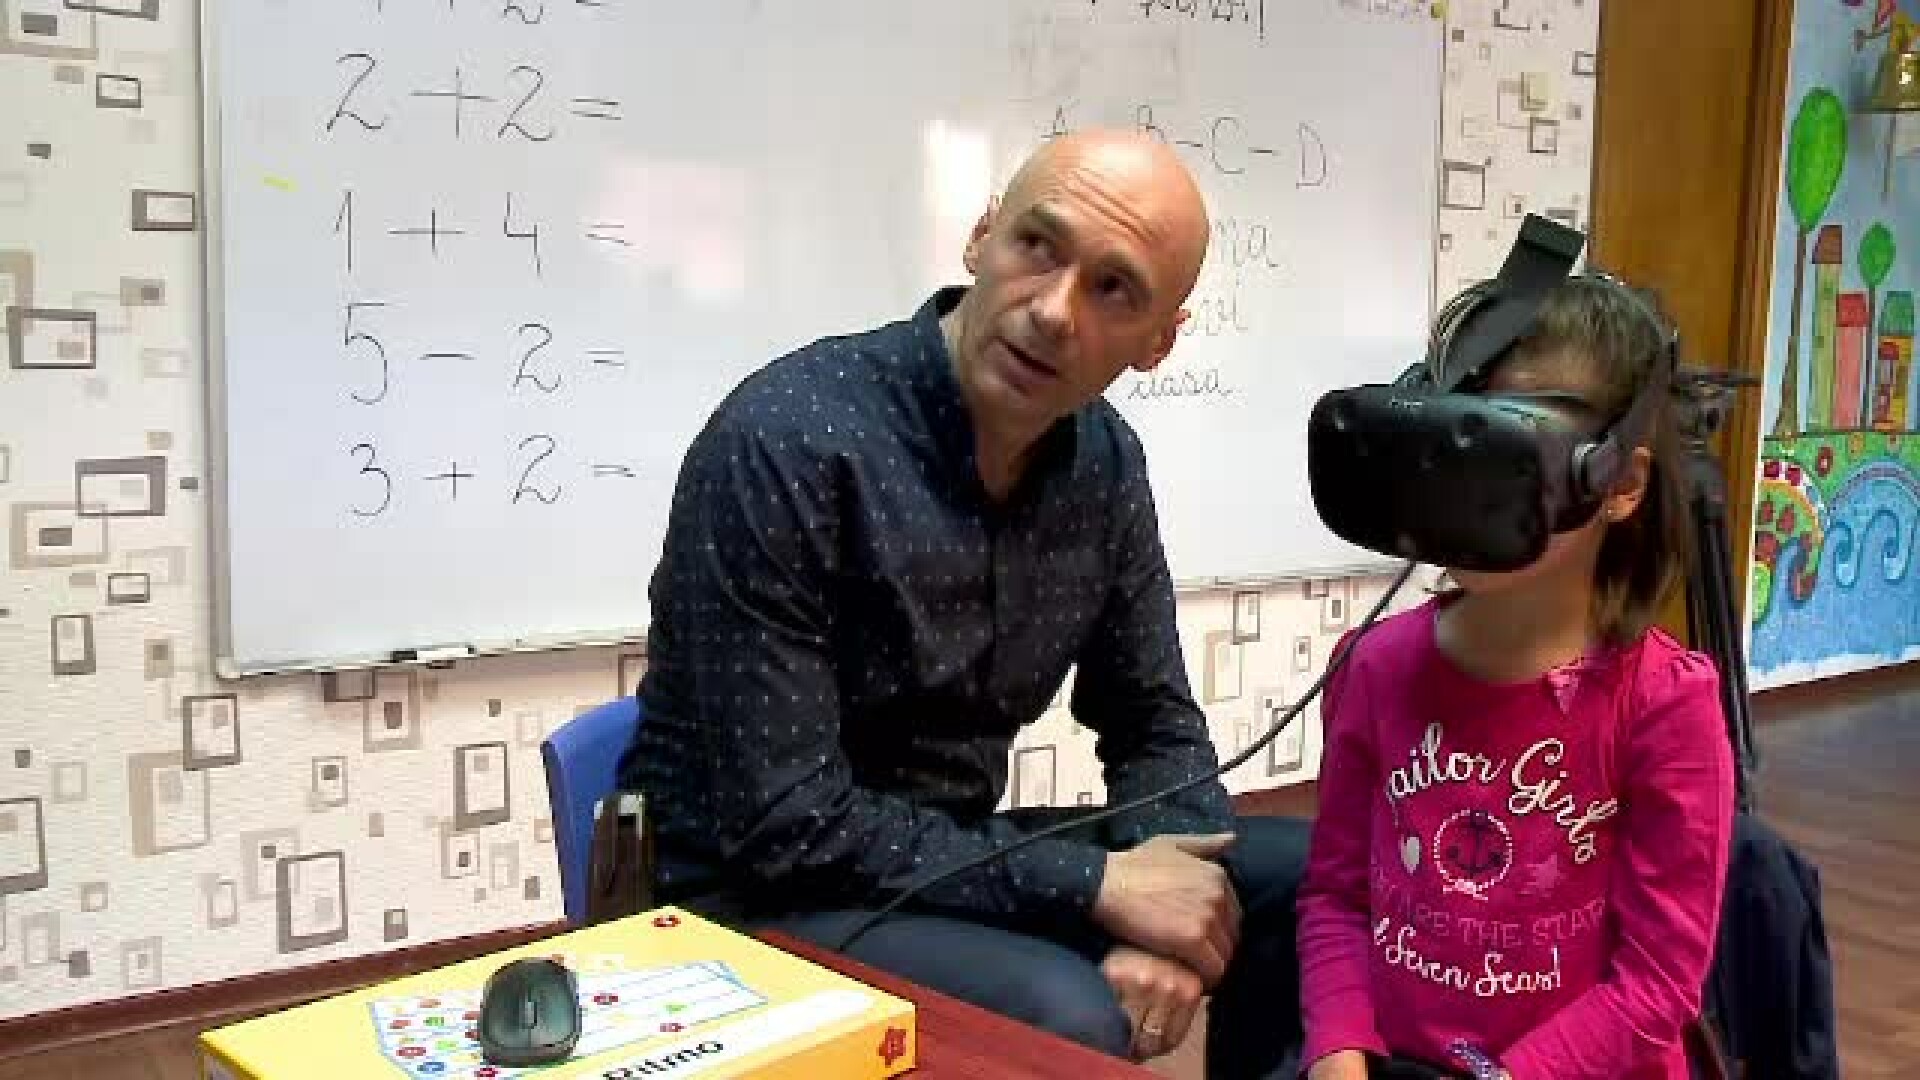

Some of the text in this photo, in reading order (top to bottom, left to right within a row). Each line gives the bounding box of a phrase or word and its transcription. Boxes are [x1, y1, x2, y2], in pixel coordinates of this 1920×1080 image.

[326, 53, 389, 132] 2
[498, 65, 555, 141] 2
[1294, 122, 1329, 188] D
[335, 190, 353, 274] 1
[503, 191, 542, 276] 4
[344, 302, 391, 405] 5
[513, 322, 562, 393] 2
[350, 443, 391, 517] 3
[512, 434, 562, 504] 2
[1385, 721, 1507, 803] ailor
[1457, 917, 1522, 949] THE
